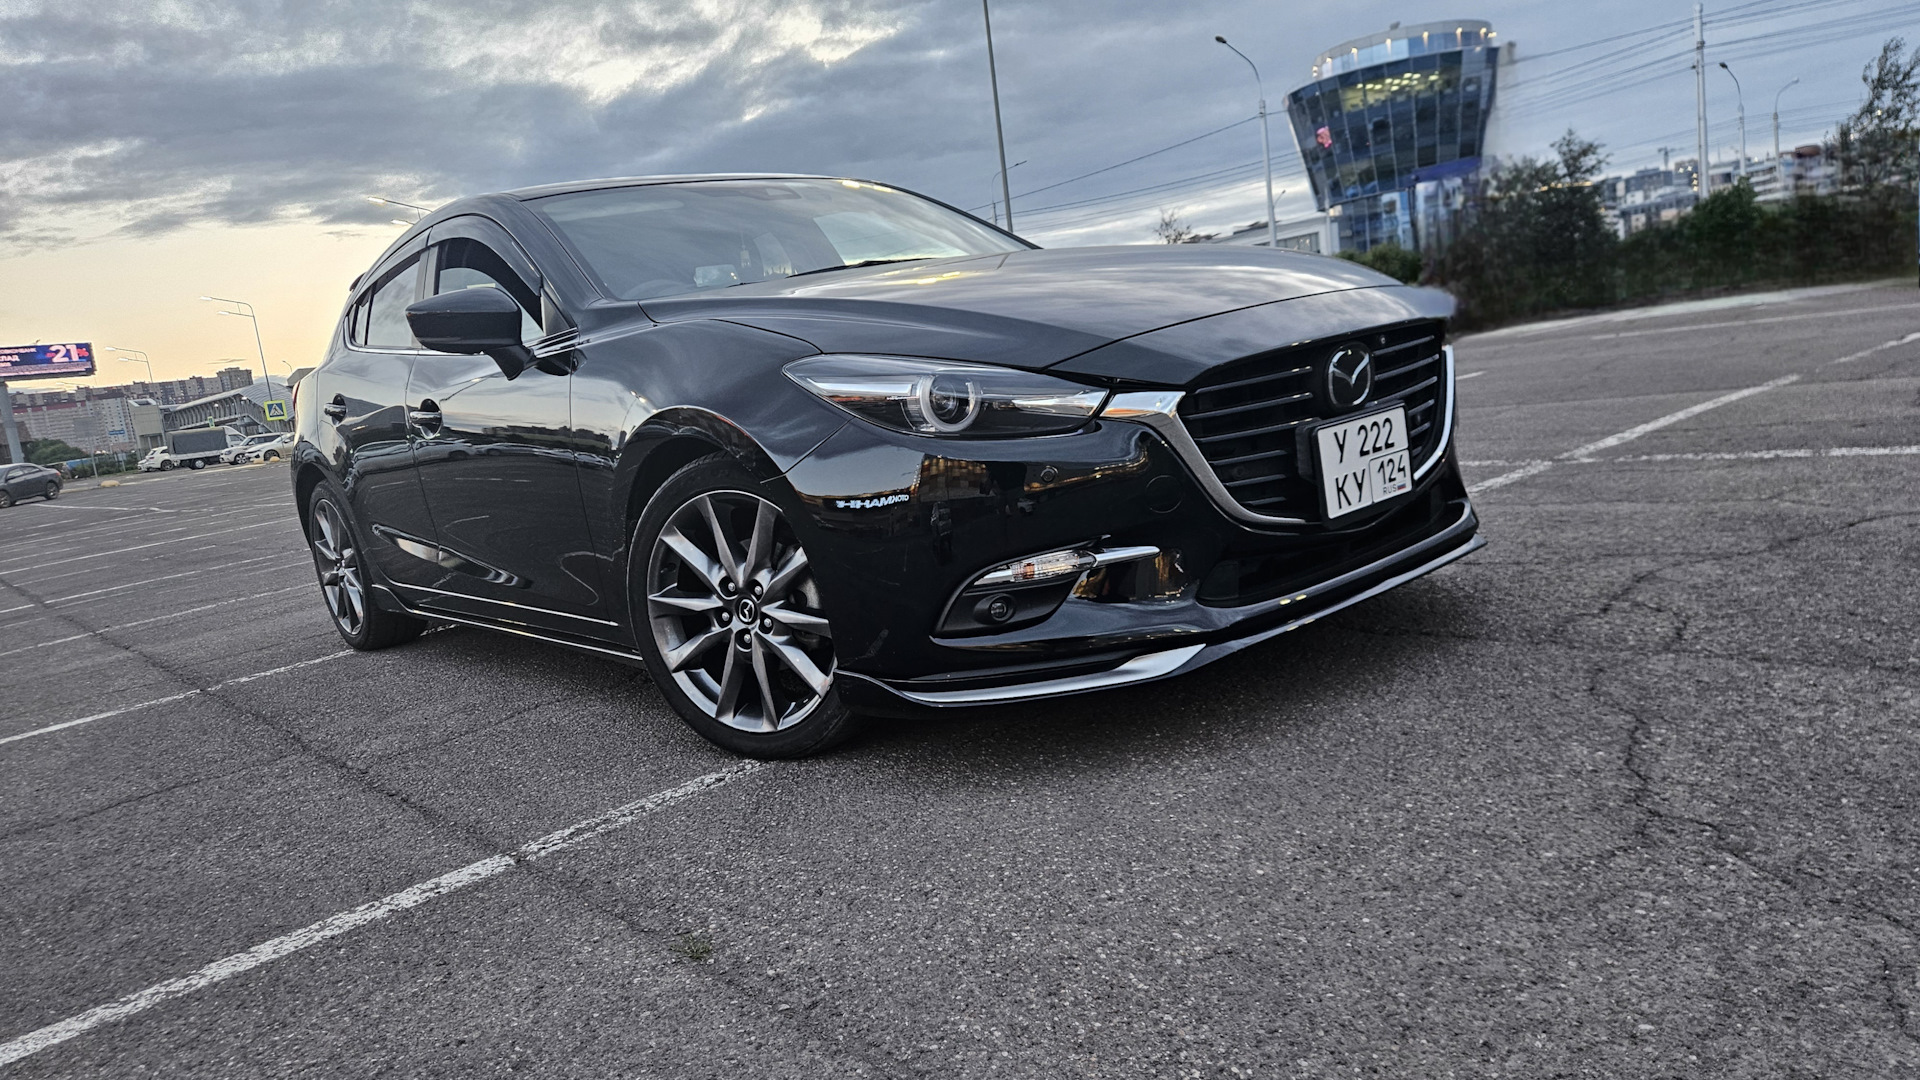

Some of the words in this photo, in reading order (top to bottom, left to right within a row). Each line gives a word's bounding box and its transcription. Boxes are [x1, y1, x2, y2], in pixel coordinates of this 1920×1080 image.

[1357, 417, 1395, 457] 222
[1377, 454, 1407, 485] 124
[1382, 484, 1397, 495] RUS
